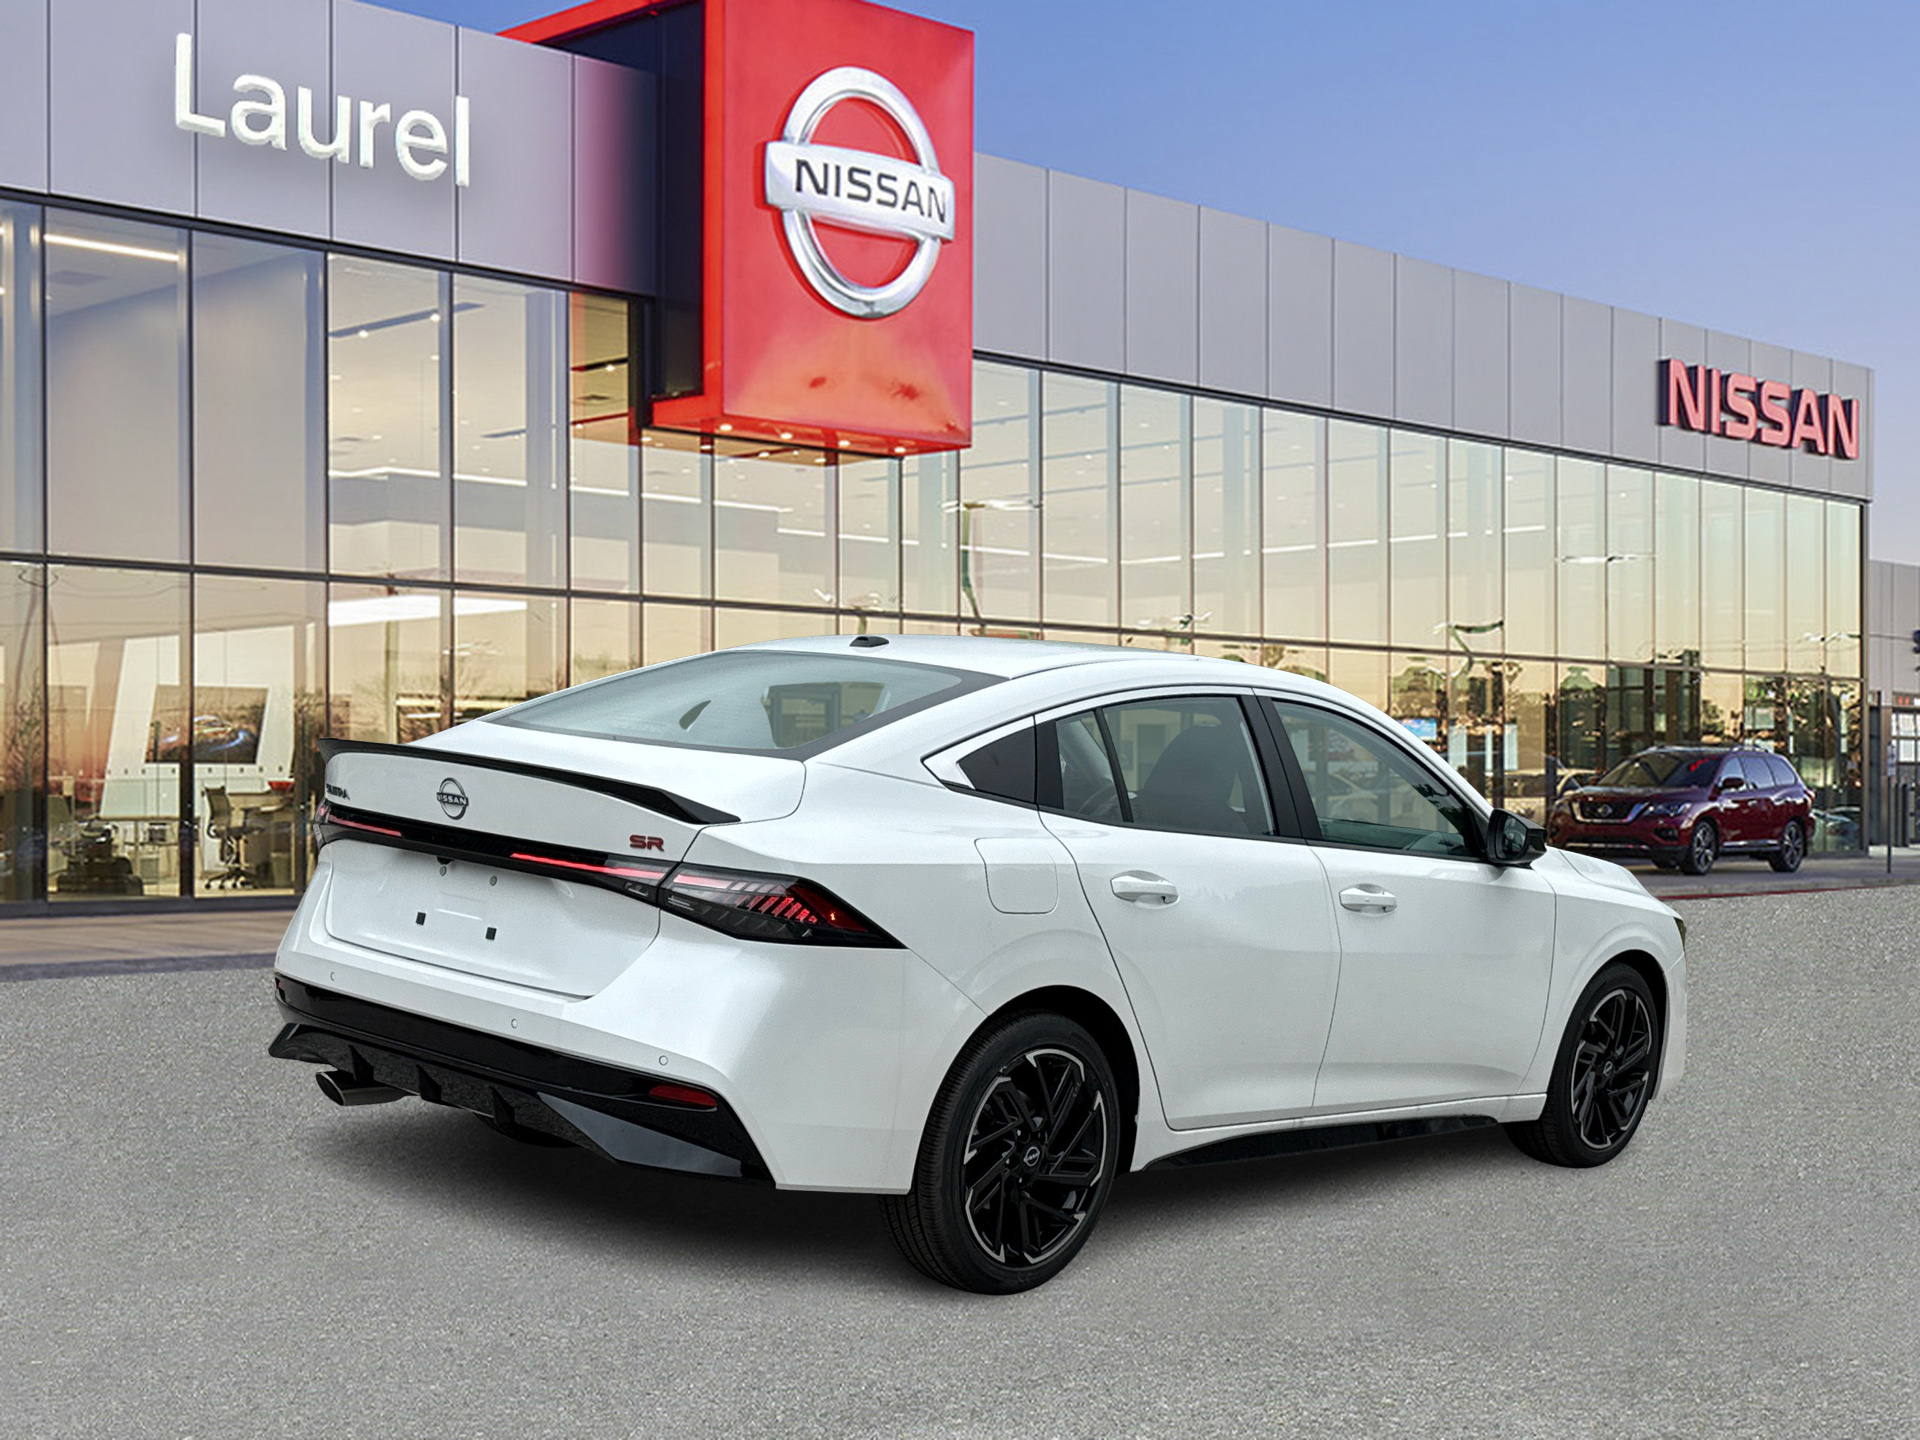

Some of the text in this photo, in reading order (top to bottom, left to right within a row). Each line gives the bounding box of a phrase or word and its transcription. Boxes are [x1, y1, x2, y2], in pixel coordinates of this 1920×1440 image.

[175, 33, 470, 187] Laurel
[795, 158, 946, 223] NISSAN
[1660, 358, 1860, 460] NISSAN
[629, 834, 665, 852] SR
